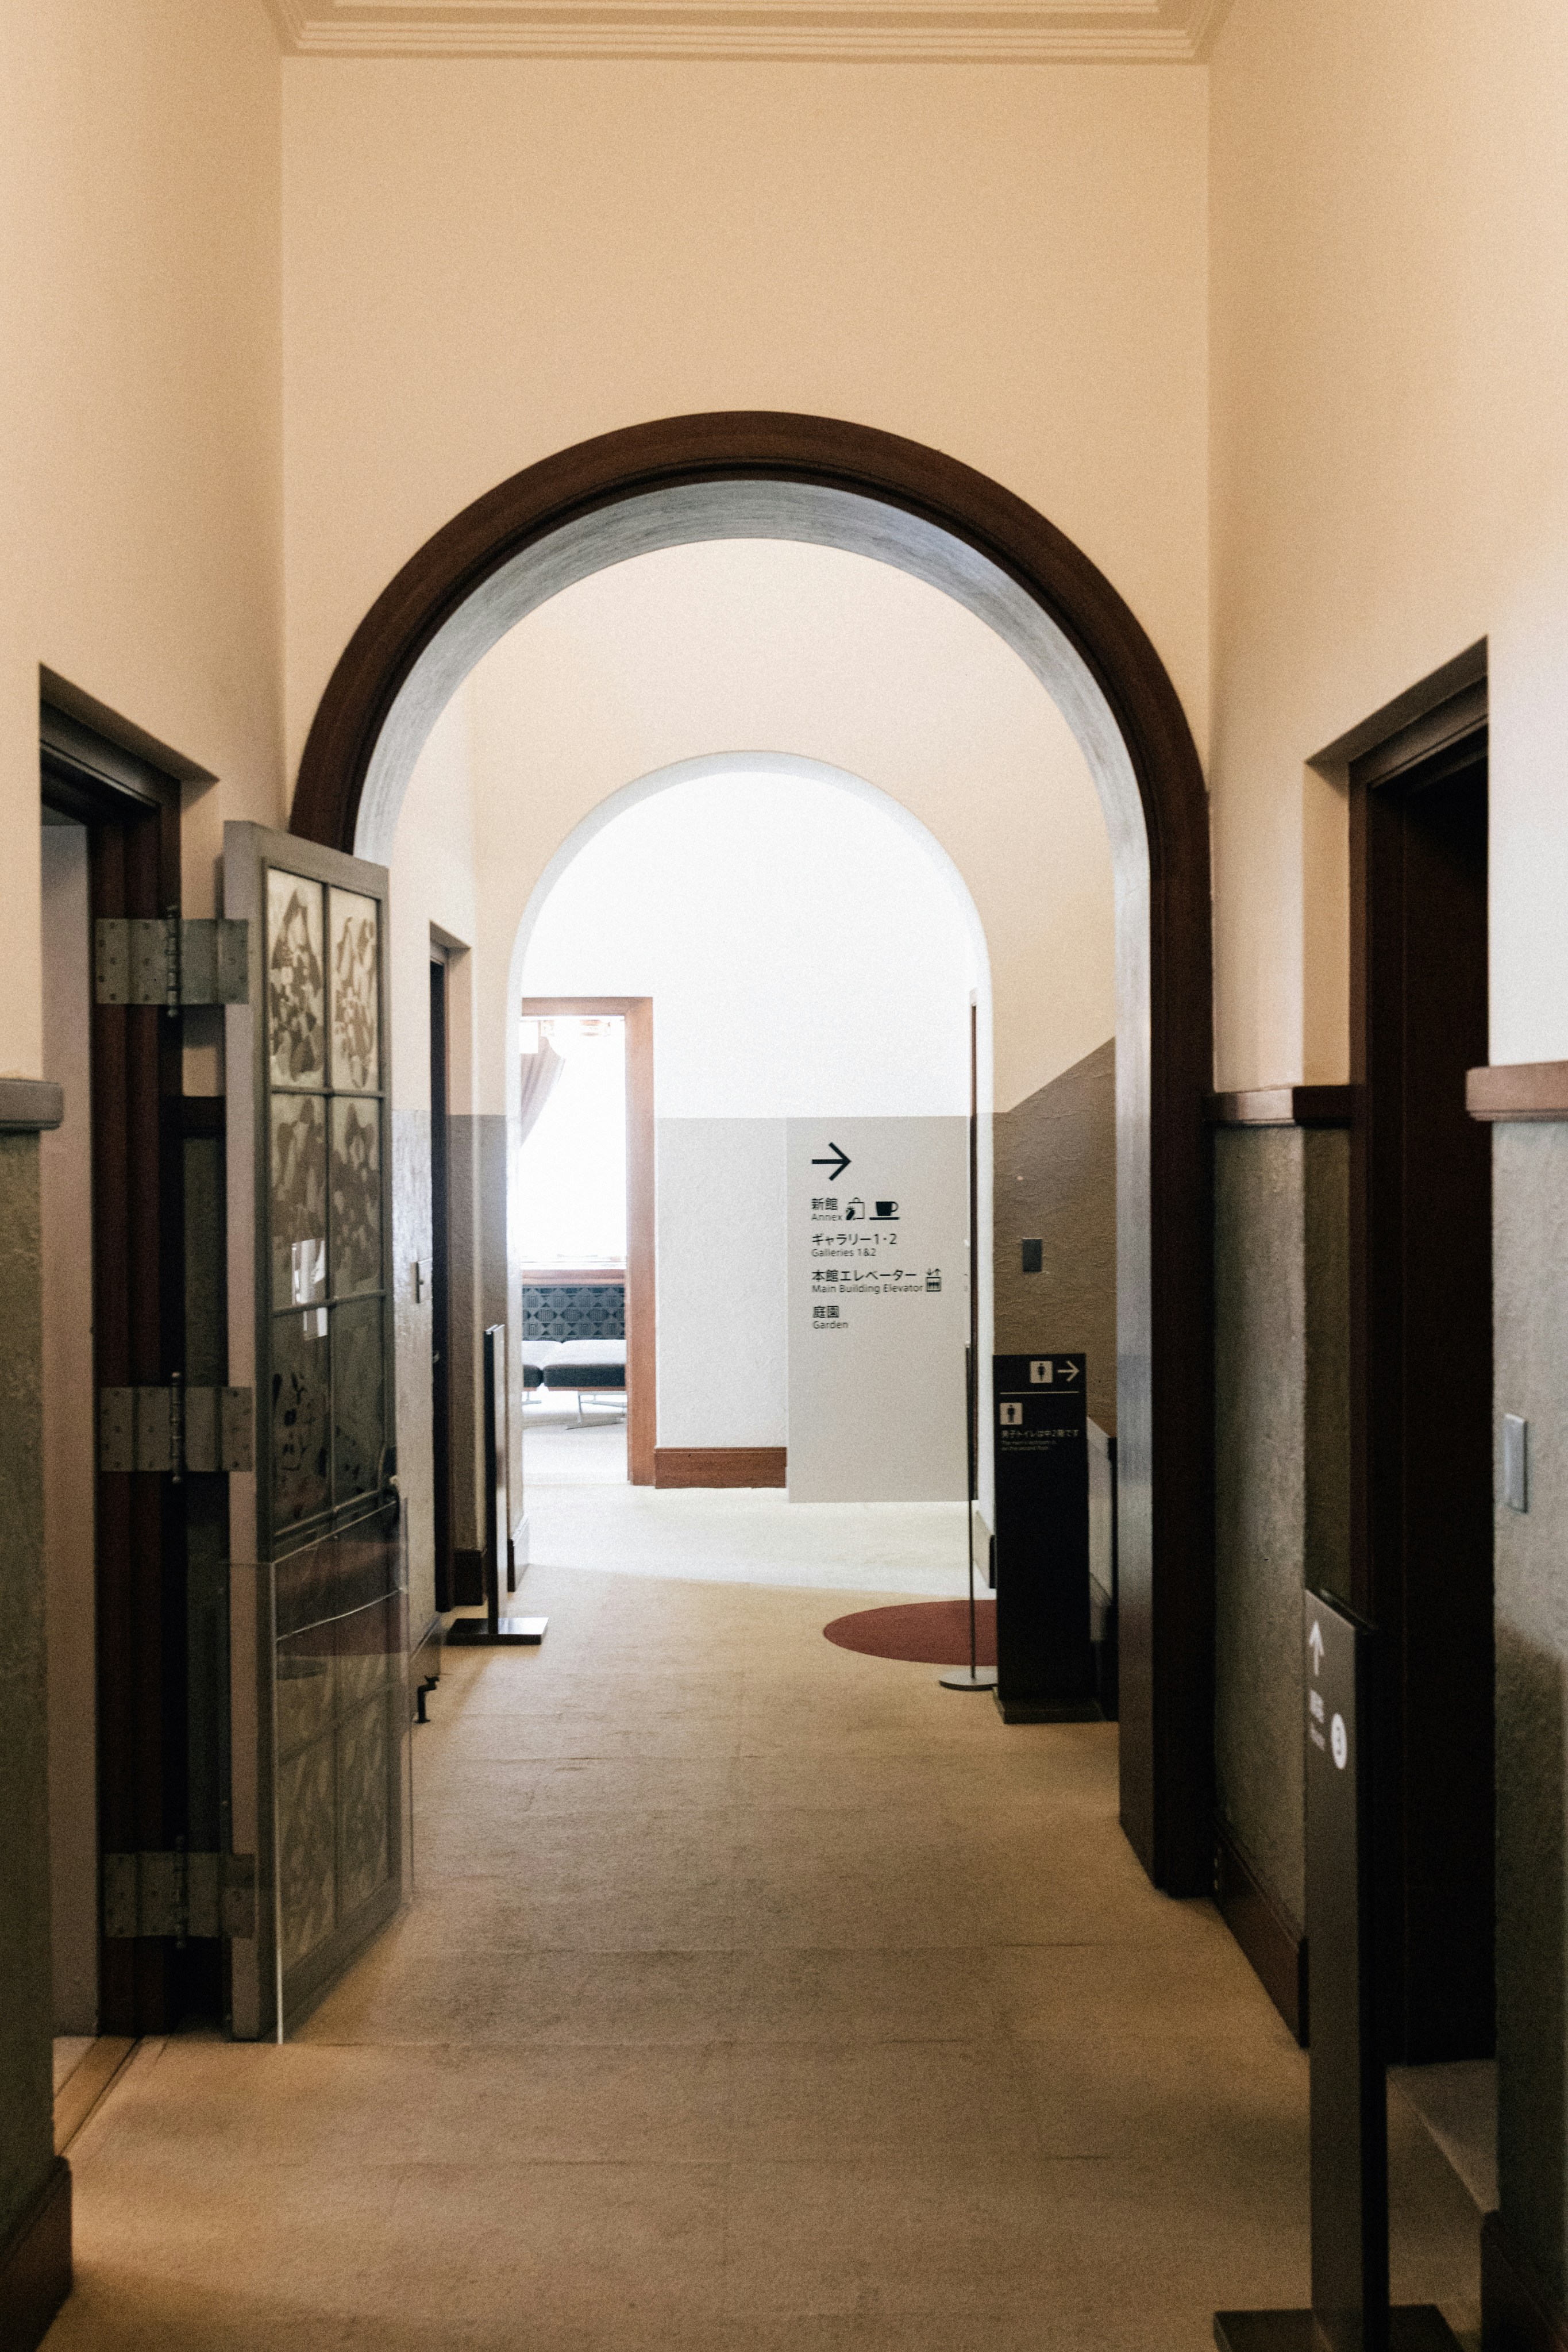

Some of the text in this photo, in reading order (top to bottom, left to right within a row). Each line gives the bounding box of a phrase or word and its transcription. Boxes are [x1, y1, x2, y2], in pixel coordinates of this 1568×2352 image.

[811, 1198, 838, 1210] 新館
[811, 1248, 877, 1257] Galleries 1&2
[811, 1269, 917, 1282] 本館エレベーター
[811, 1283, 923, 1295] Main Building Elevator
[812, 1305, 839, 1318] 庭園
[812, 1320, 849, 1329] Garden
